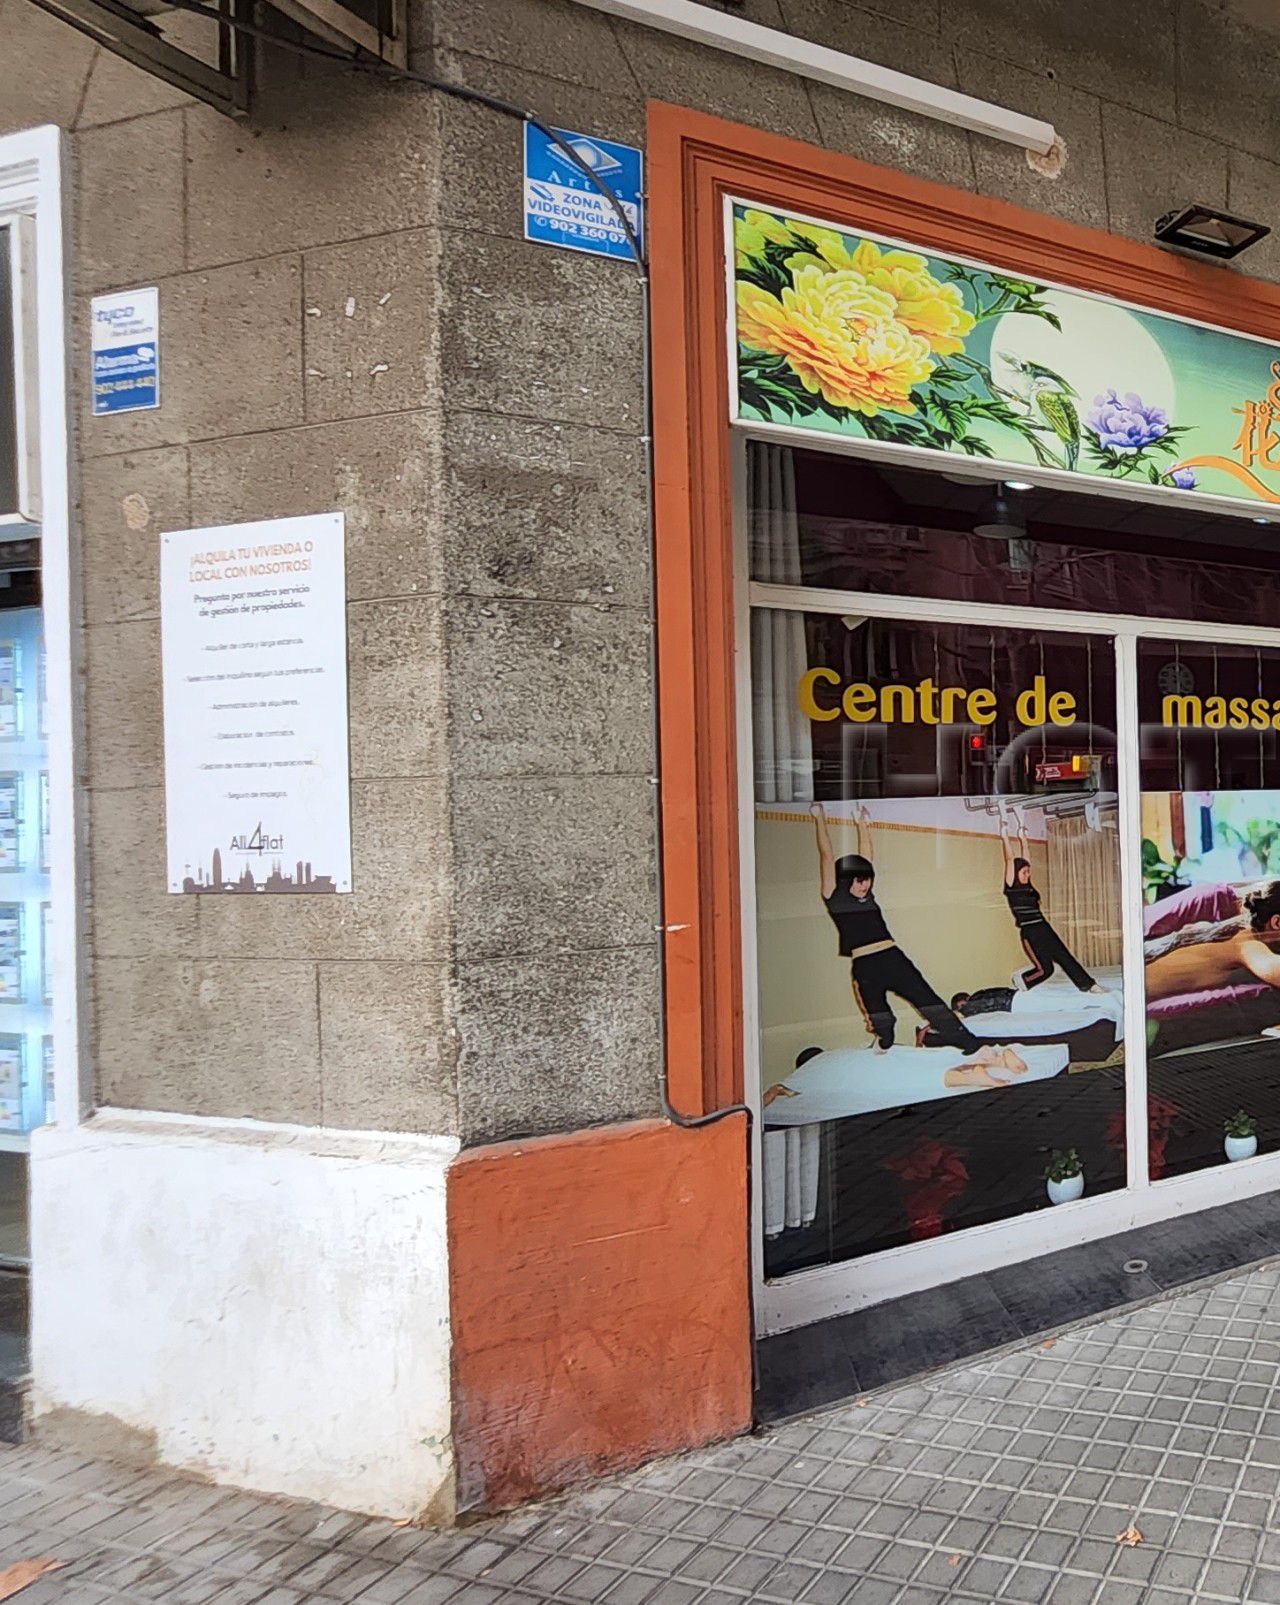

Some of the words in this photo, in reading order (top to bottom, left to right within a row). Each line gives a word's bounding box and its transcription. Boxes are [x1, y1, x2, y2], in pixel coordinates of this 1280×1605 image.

[547, 170, 623, 198] Arts
[563, 192, 602, 211] ZONA
[549, 218, 578, 234] 902
[580, 226, 607, 241] 360
[608, 231, 632, 246] 07
[238, 547, 250, 559] TU
[252, 542, 302, 558] VIVIENDA
[304, 540, 313, 552] O
[189, 569, 222, 583] LOCAL
[224, 565, 247, 579] CON
[231, 591, 245, 602] por
[279, 583, 310, 595] servicio
[199, 606, 209, 616] de
[240, 602, 250, 612] de
[799, 667, 998, 725] Centre
[1015, 675, 1077, 727] de
